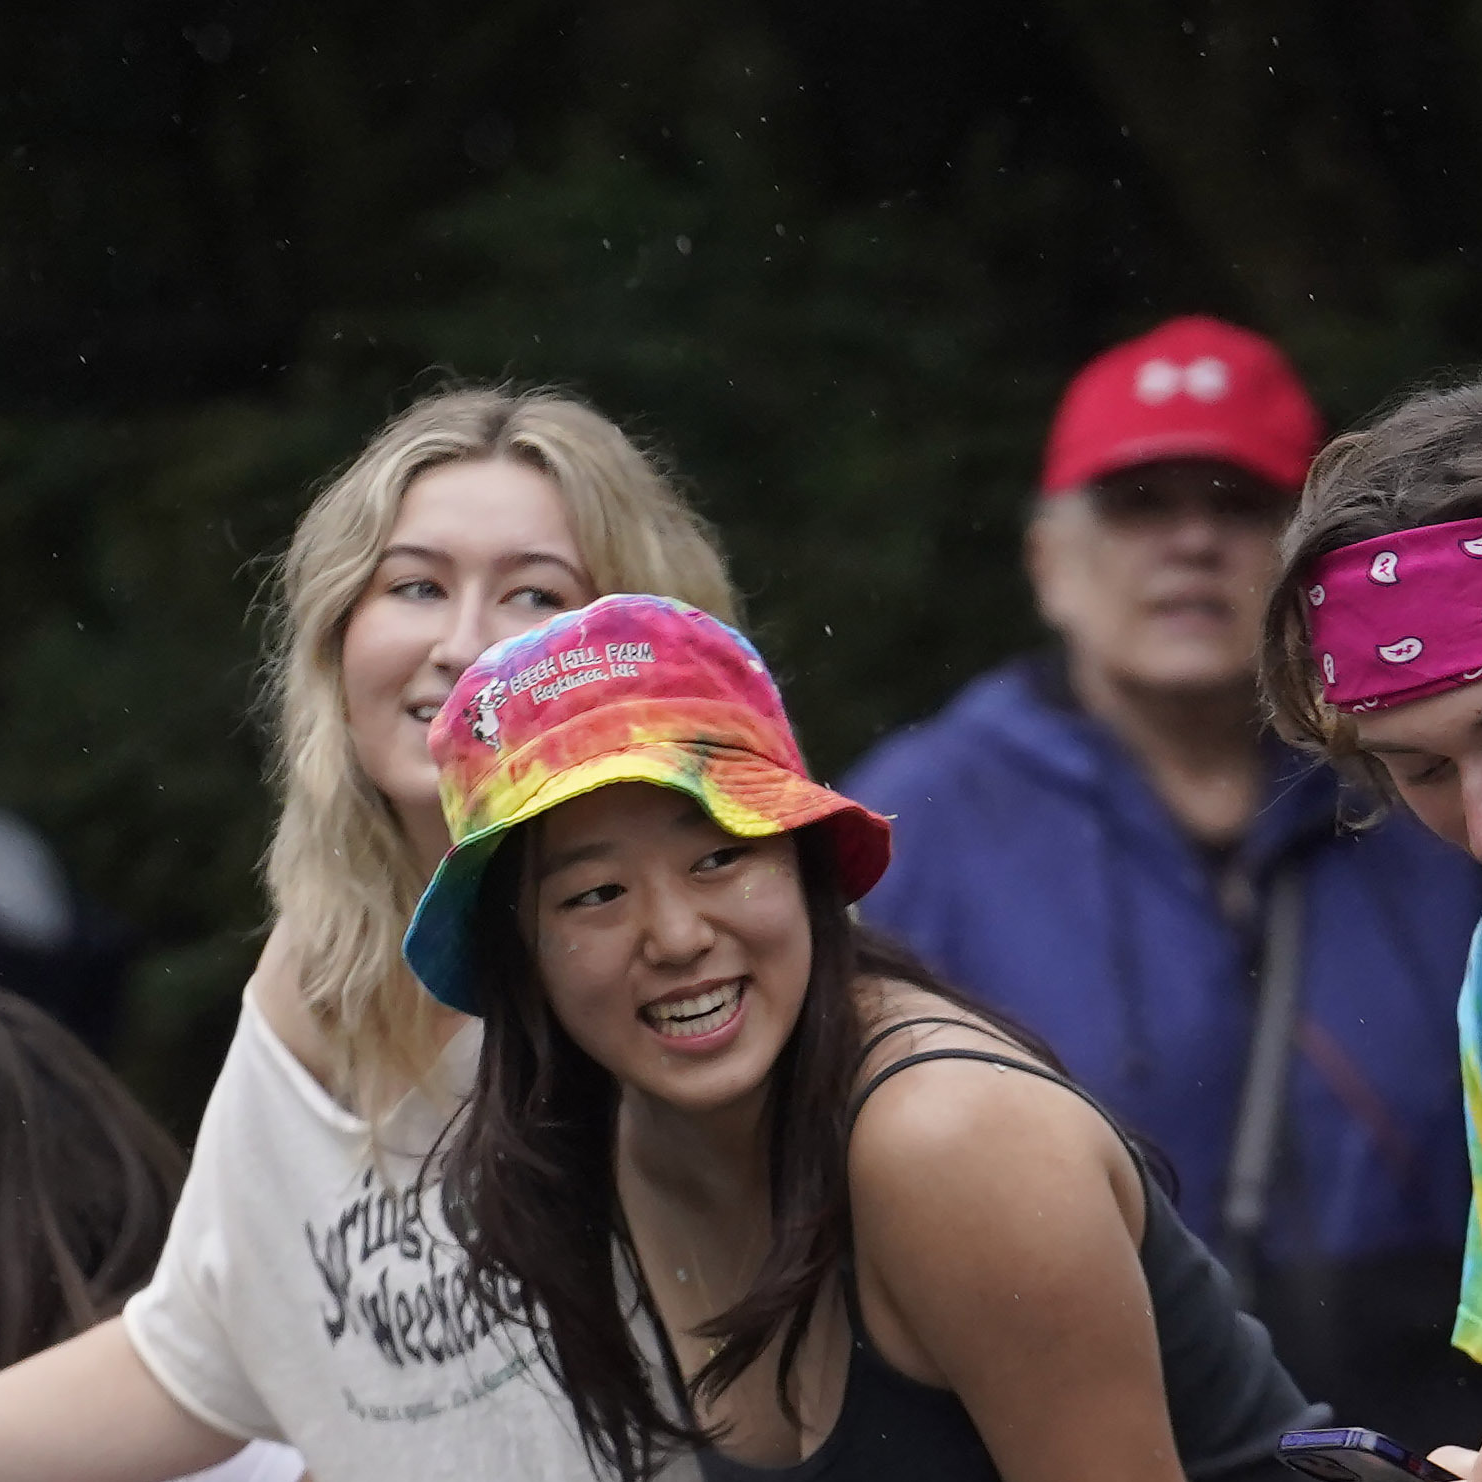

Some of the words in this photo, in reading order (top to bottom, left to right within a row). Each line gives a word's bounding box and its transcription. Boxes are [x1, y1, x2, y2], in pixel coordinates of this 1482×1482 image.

[509, 656, 559, 696] BEECH
[559, 647, 604, 672] HILL
[605, 643, 656, 663] FARM
[531, 668, 610, 705] Hopkinton,
[610, 664, 640, 678] NH
